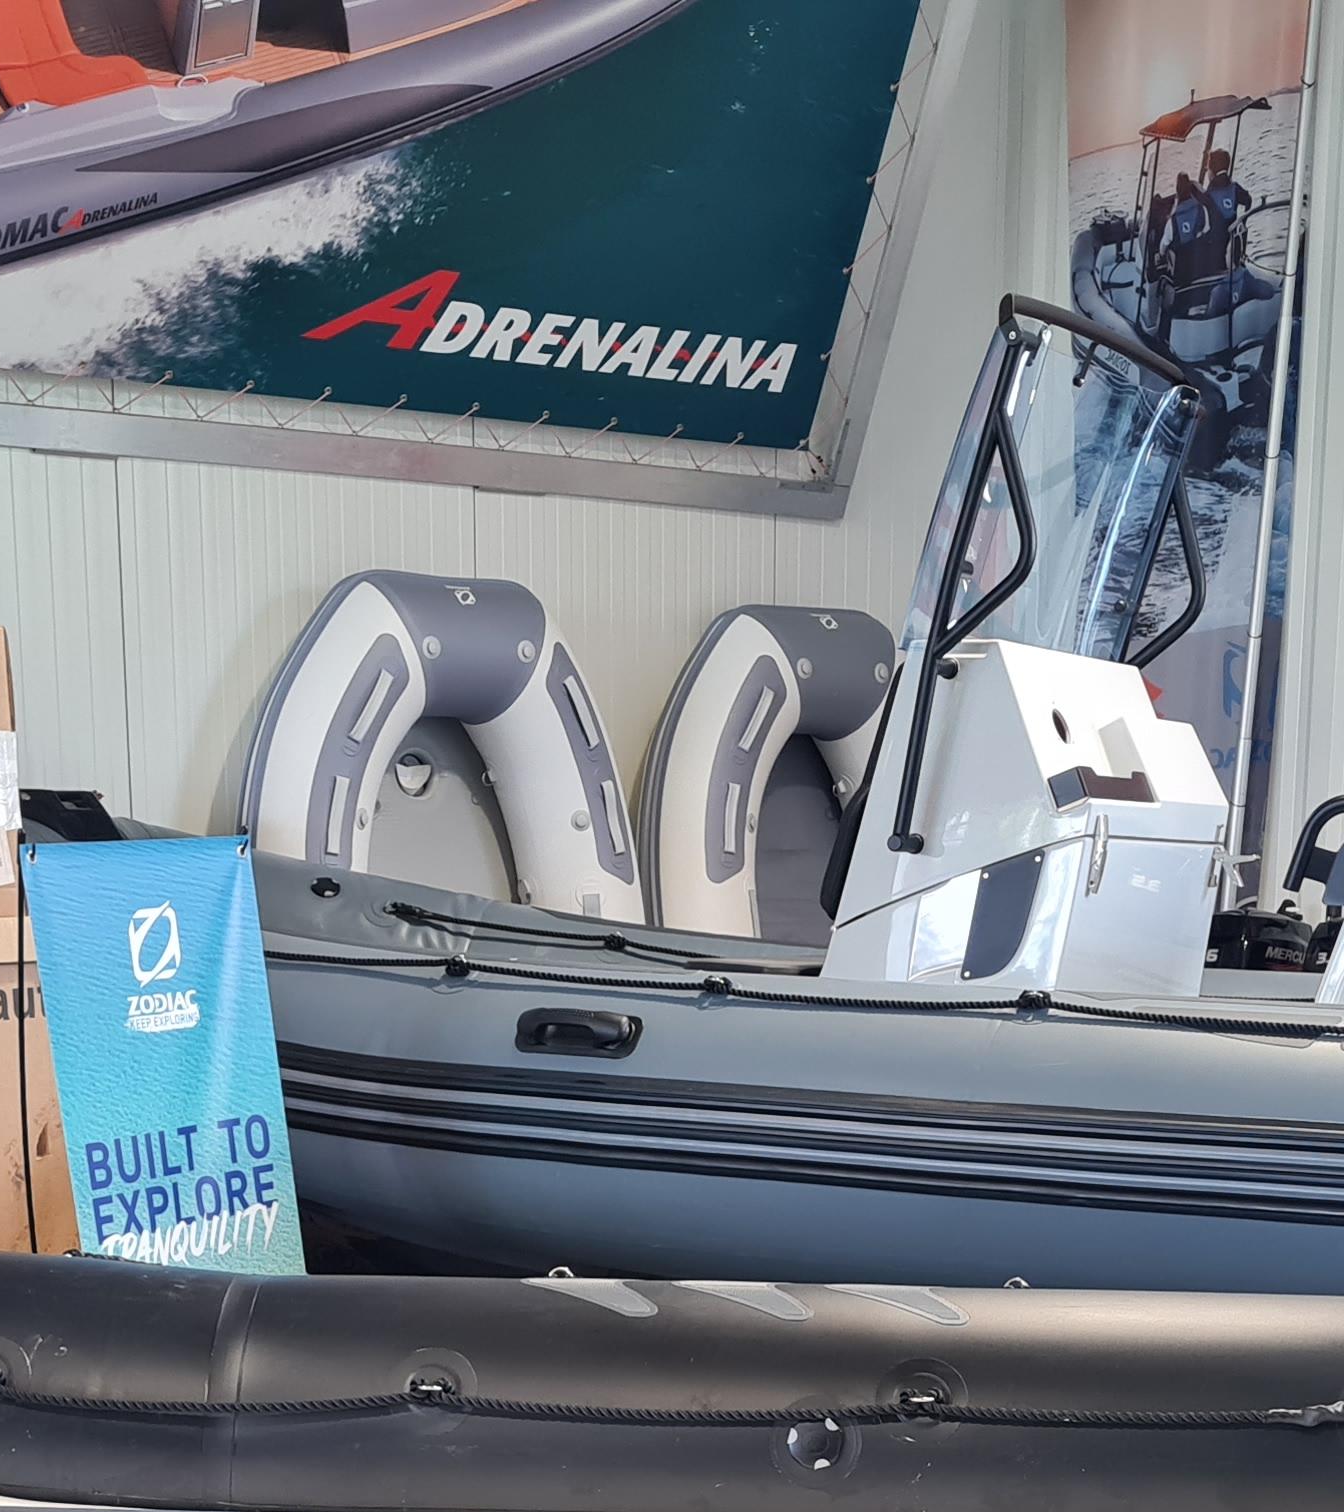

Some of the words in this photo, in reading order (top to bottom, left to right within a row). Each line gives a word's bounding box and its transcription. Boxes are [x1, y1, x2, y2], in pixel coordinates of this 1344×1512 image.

[58, 192, 158, 235] ADRENALINA
[300, 269, 798, 393] ADRENALINA
[127, 989, 199, 1017] ZODIAC
[129, 1017, 151, 1031] KEEP
[85, 1124, 198, 1191] BUILT
[217, 1114, 271, 1164] TO
[92, 1163, 279, 1245] EXPLORE
[100, 1201, 280, 1266] TRANQUILITY
